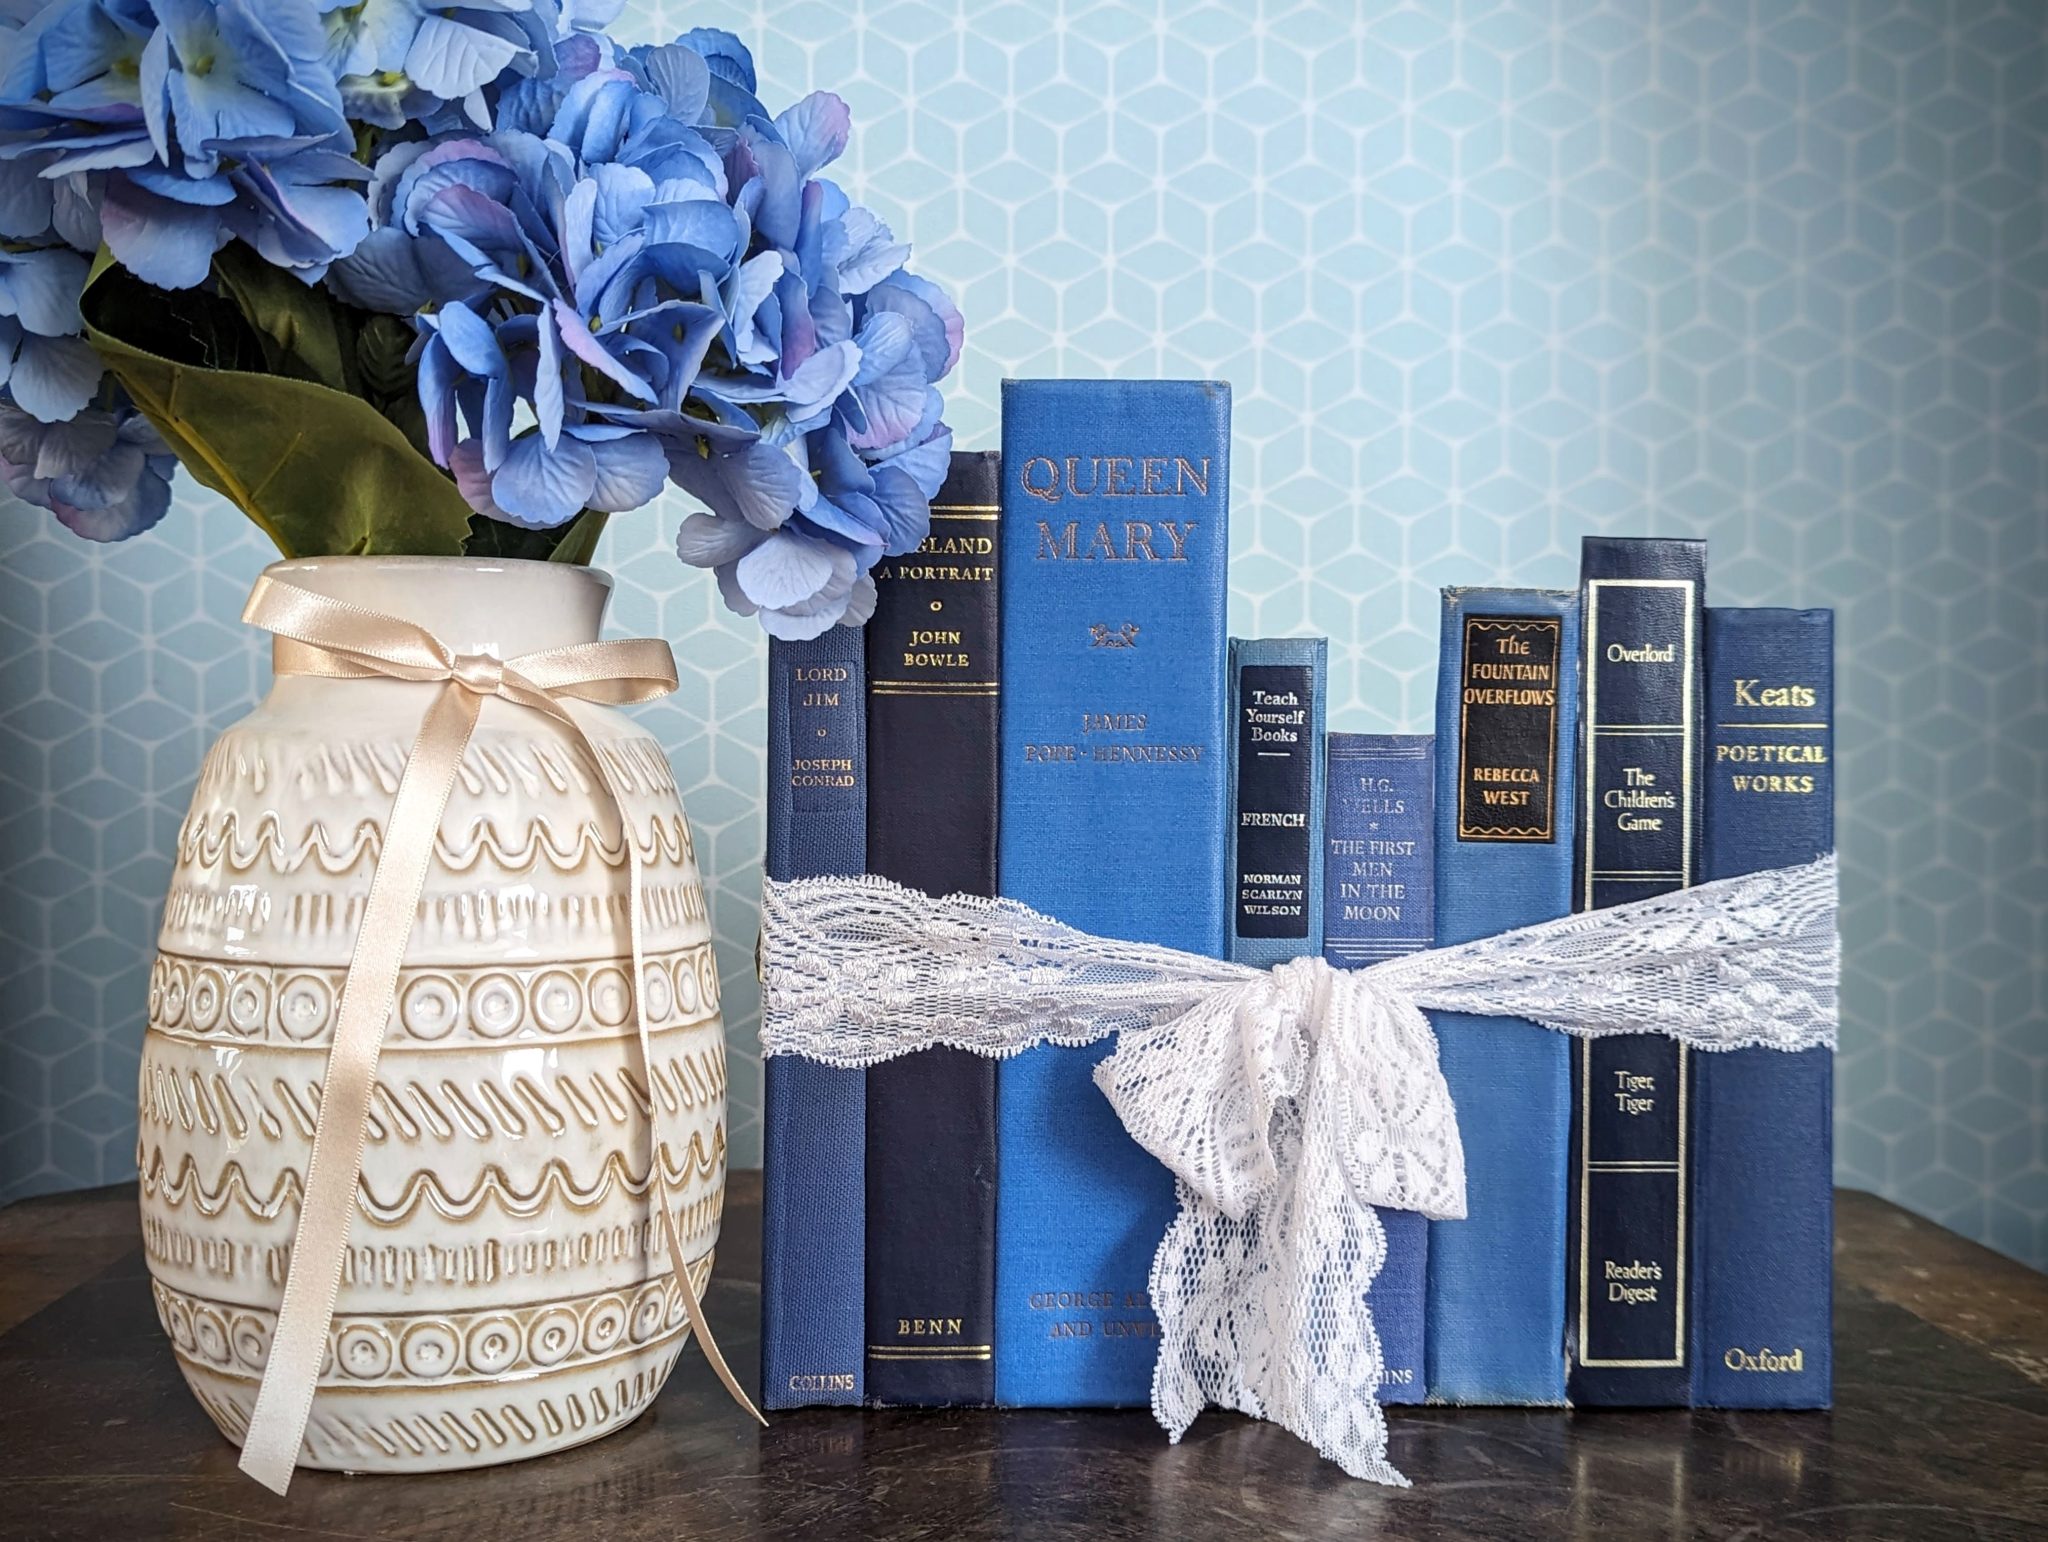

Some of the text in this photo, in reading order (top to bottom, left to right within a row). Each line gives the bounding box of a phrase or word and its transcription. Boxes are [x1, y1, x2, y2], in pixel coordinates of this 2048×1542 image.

[1021, 456, 1212, 503] QUEEN
[916, 537, 993, 554] GLAND
[1035, 520, 1199, 561] MARY
[880, 566, 994, 581] A PORTRAIT
[909, 631, 961, 647] JOHN
[1496, 634, 1531, 656] The
[903, 653, 969, 667] BOWLE
[1607, 643, 1675, 663] Overlord
[795, 668, 847, 682] LORD
[1472, 664, 1549, 680] FOUNTAIN
[803, 694, 840, 706] JIM
[1253, 690, 1299, 706] Teach
[1464, 687, 1555, 706] OVERFLOWS
[1733, 678, 1816, 708] Keats
[1082, 713, 1148, 735] JAMES
[1246, 708, 1306, 725] Yourself
[1251, 727, 1298, 743] Books
[1716, 745, 1828, 764] POETICAL
[792, 759, 853, 771] JOSEPH
[791, 775, 855, 787] CONRAD
[1473, 768, 1540, 783] REBECCA
[1623, 768, 1656, 787] The
[1732, 775, 1814, 793] WORKS
[1483, 791, 1530, 806] WEST
[1604, 790, 1676, 810] Children's
[1241, 813, 1306, 827] FRENCH
[1617, 812, 1663, 831] Game
[1331, 839, 1416, 856] THE FIRST
[1352, 862, 1393, 878] MEN
[1243, 874, 1302, 885] NORMAN
[1242, 890, 1303, 900] SCARLYN
[1340, 884, 1405, 899] IN THE
[1244, 905, 1302, 916] WILSON
[1343, 906, 1401, 921] MOON
[1615, 1093, 1655, 1115] Tiger
[1605, 1260, 1663, 1281] Reader's
[1609, 1283, 1658, 1305] Digest
[898, 1319, 961, 1335] BENN
[1724, 1347, 1805, 1373] Oxford
